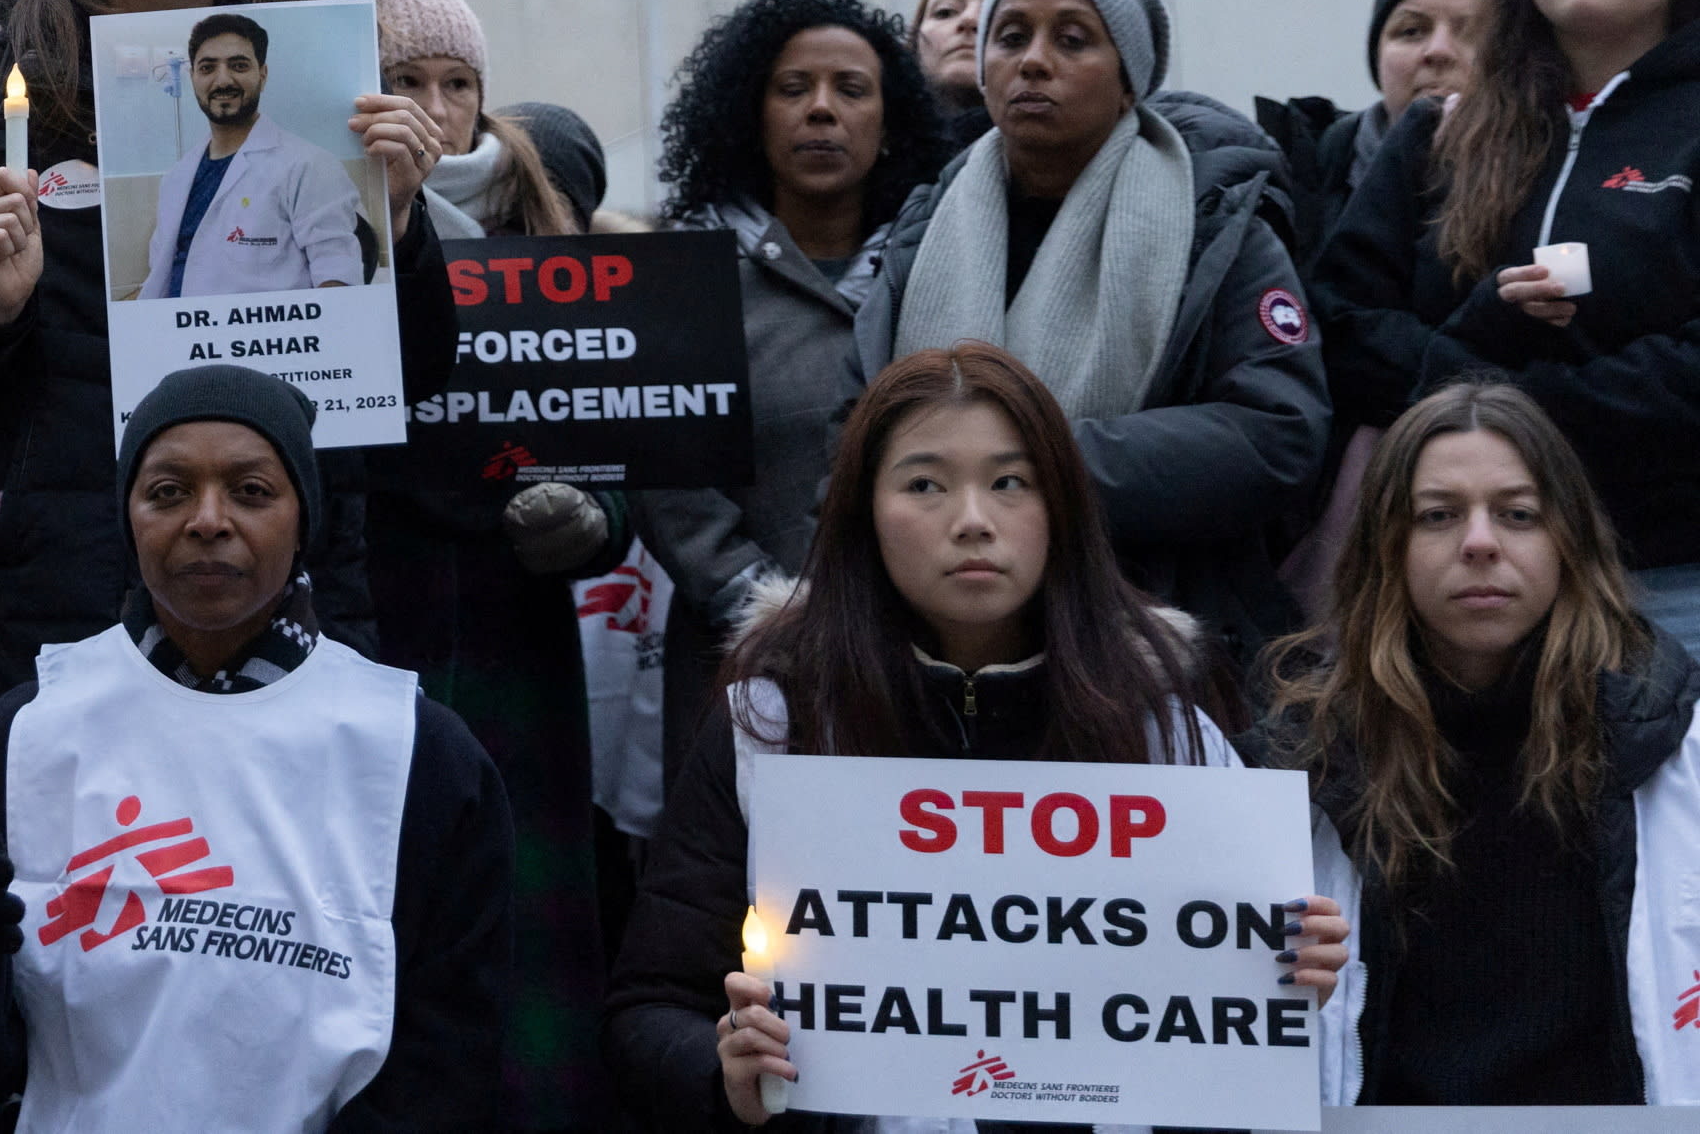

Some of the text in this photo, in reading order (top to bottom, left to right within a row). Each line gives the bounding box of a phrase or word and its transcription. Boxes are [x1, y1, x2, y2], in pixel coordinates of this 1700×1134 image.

[449, 255, 634, 306] STOP
[176, 302, 322, 329] DR. AHMAD
[189, 335, 320, 360] AL SAHAR
[324, 399, 351, 413] 21,
[355, 395, 397, 409] 2023
[405, 383, 737, 424] SPLACEMENT
[899, 788, 1166, 858] STOP
[157, 898, 296, 936] MEDECINS
[785, 888, 1286, 952] ATTACKS ON
[132, 925, 352, 980] SANS FRONTIERES
[773, 981, 1311, 1048] HEALTH CARE
[991, 1092, 1119, 1103] DOCTORS WITHOUT BORDERS
[993, 1081, 1120, 1093] MEDECINS SANS FRONTIERES
